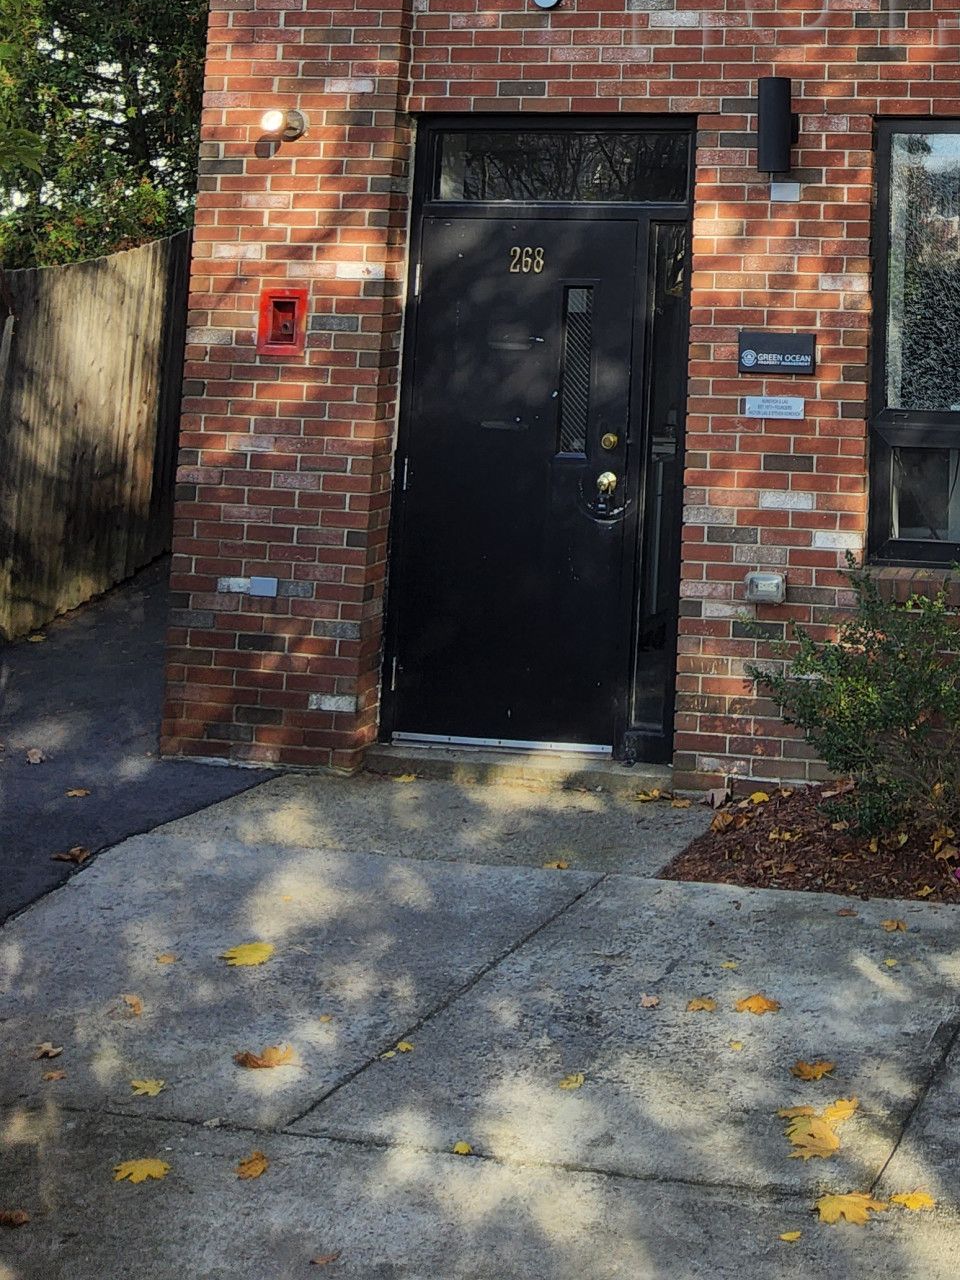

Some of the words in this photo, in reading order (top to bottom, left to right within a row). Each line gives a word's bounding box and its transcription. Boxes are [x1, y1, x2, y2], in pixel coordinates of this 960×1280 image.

[510, 246, 544, 273] 268
[757, 353, 782, 361] GREEN
[784, 354, 811, 362] OCEAN
